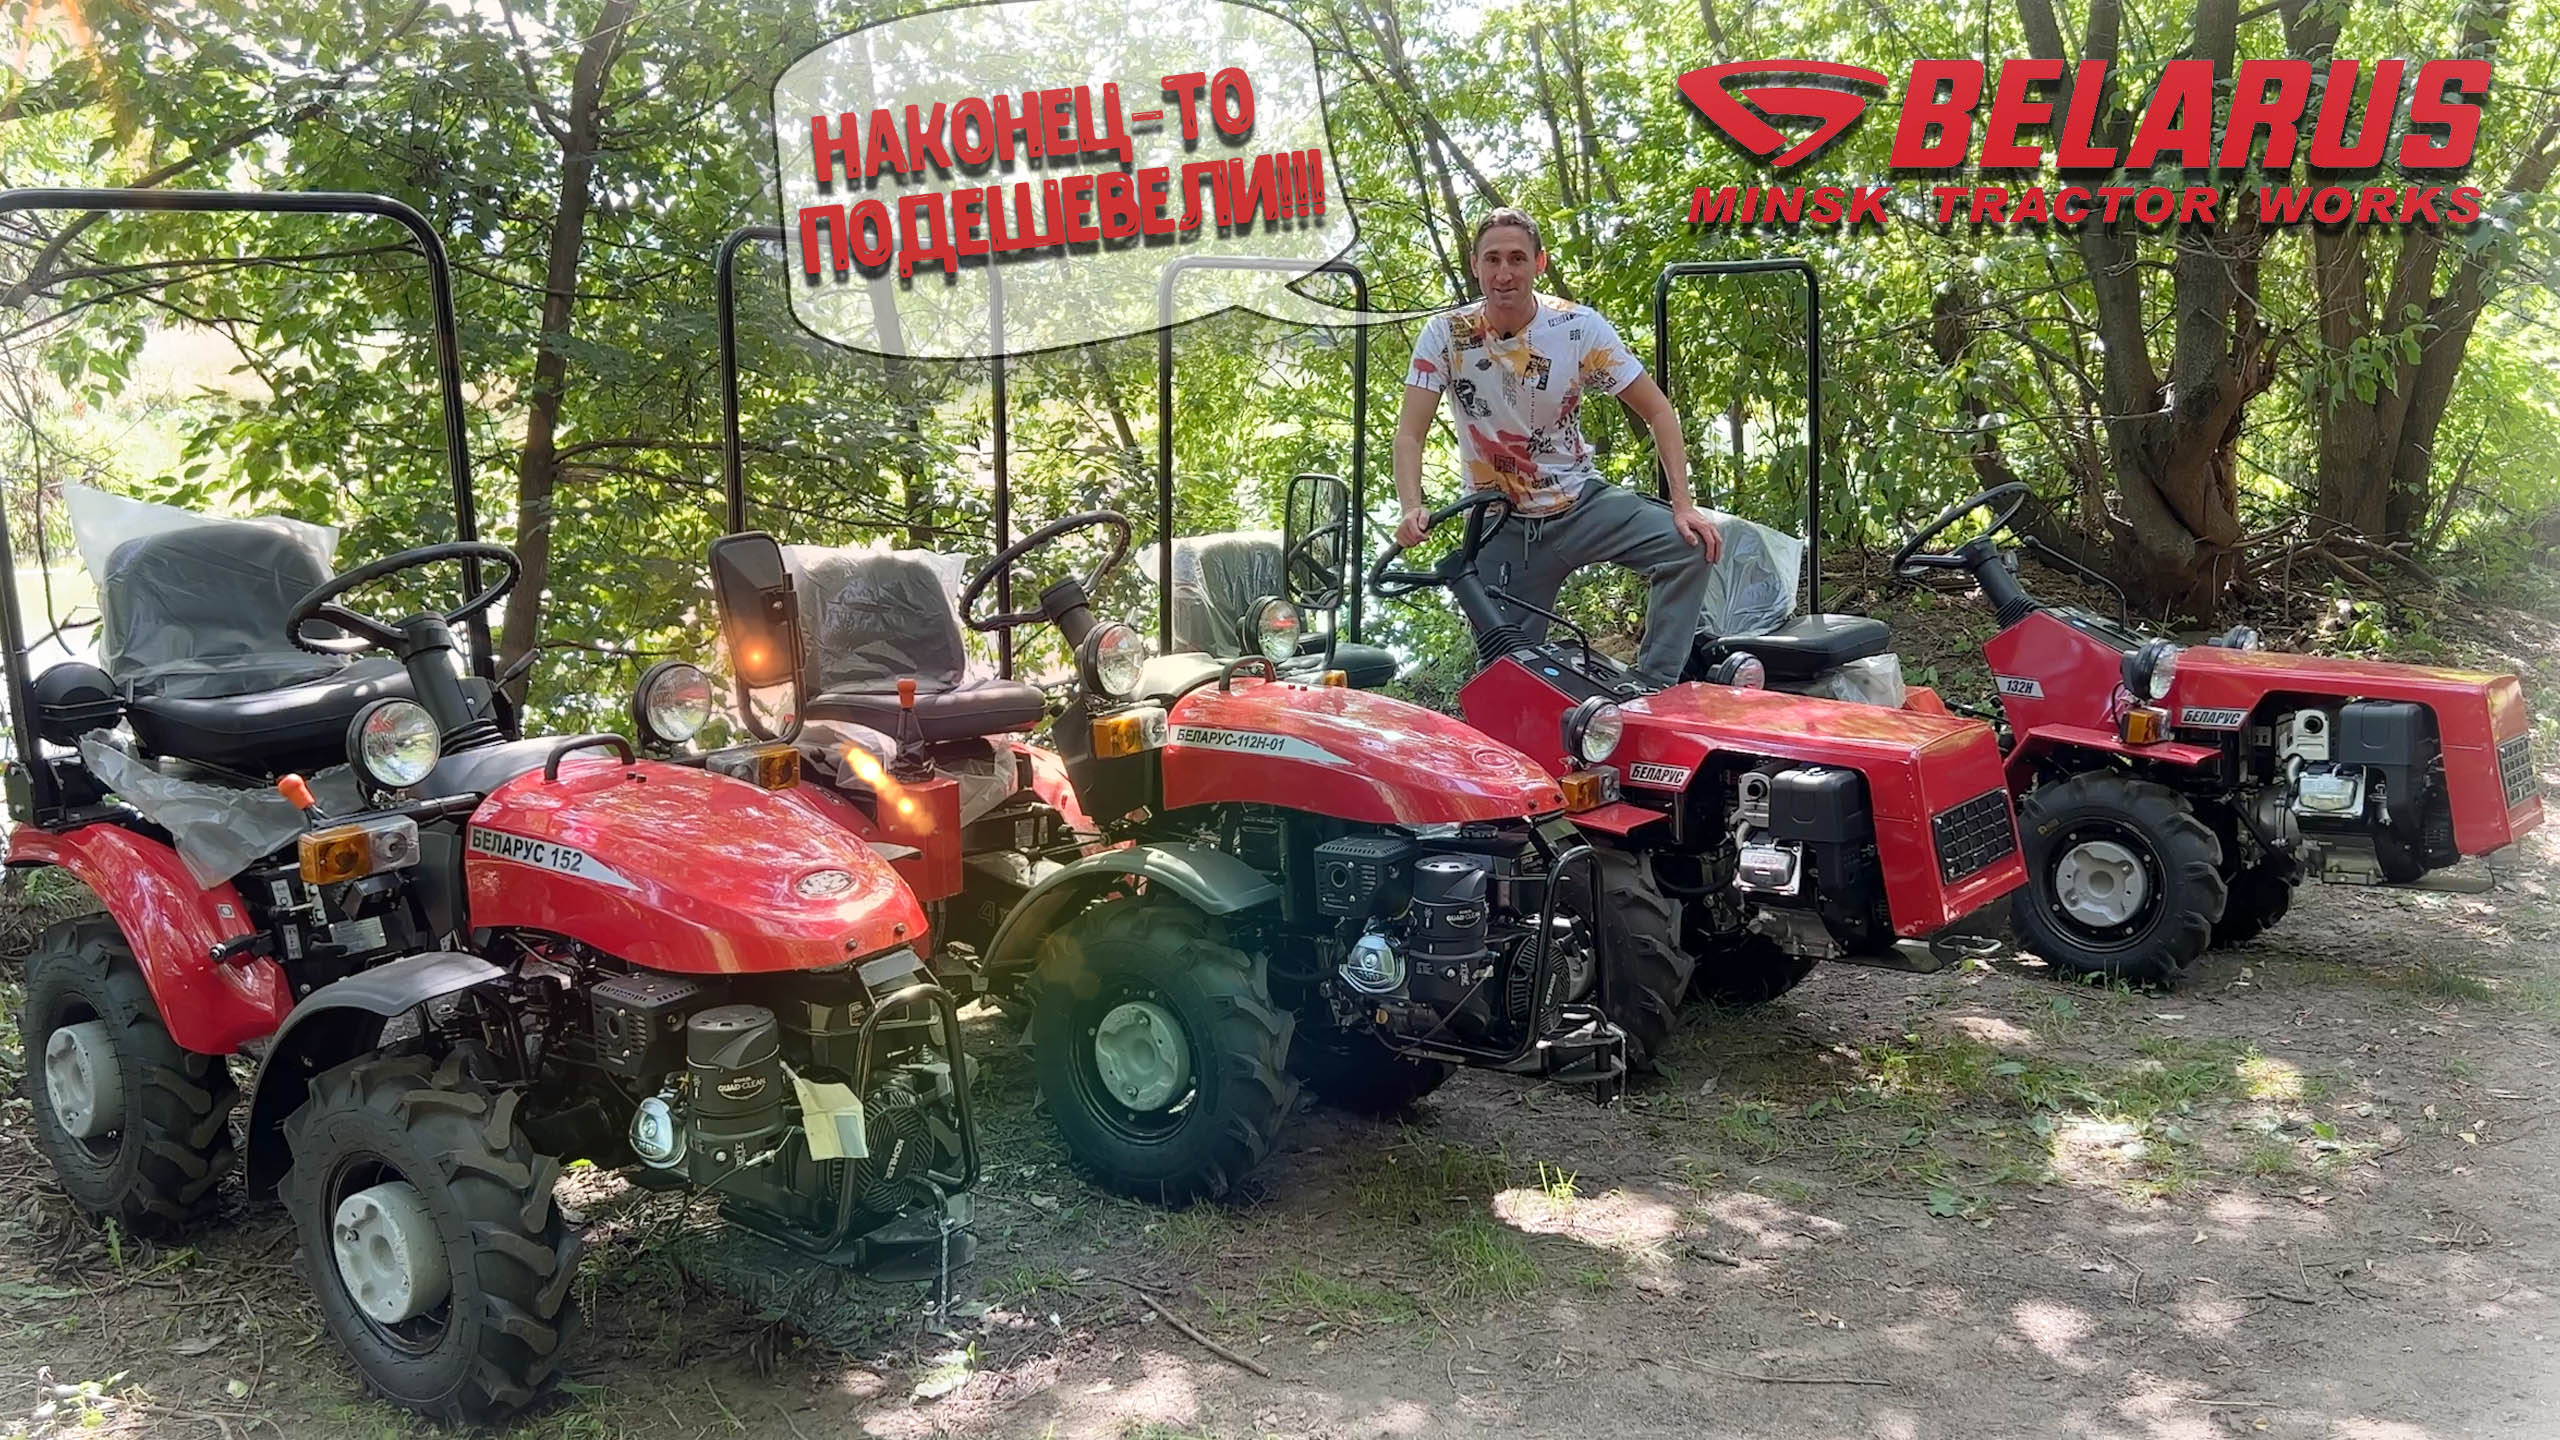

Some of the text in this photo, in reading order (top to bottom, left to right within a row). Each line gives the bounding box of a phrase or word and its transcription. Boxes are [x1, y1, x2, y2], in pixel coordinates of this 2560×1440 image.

[2183, 710, 2241, 725] БЕЛАРУС
[1177, 728, 1286, 751] БЕЛАРУС-112Н-01
[1631, 765, 1685, 784] БЕЛАРУС
[472, 828, 583, 873] БЕЛАРУС 152
[882, 1138, 905, 1181] KOHLER
